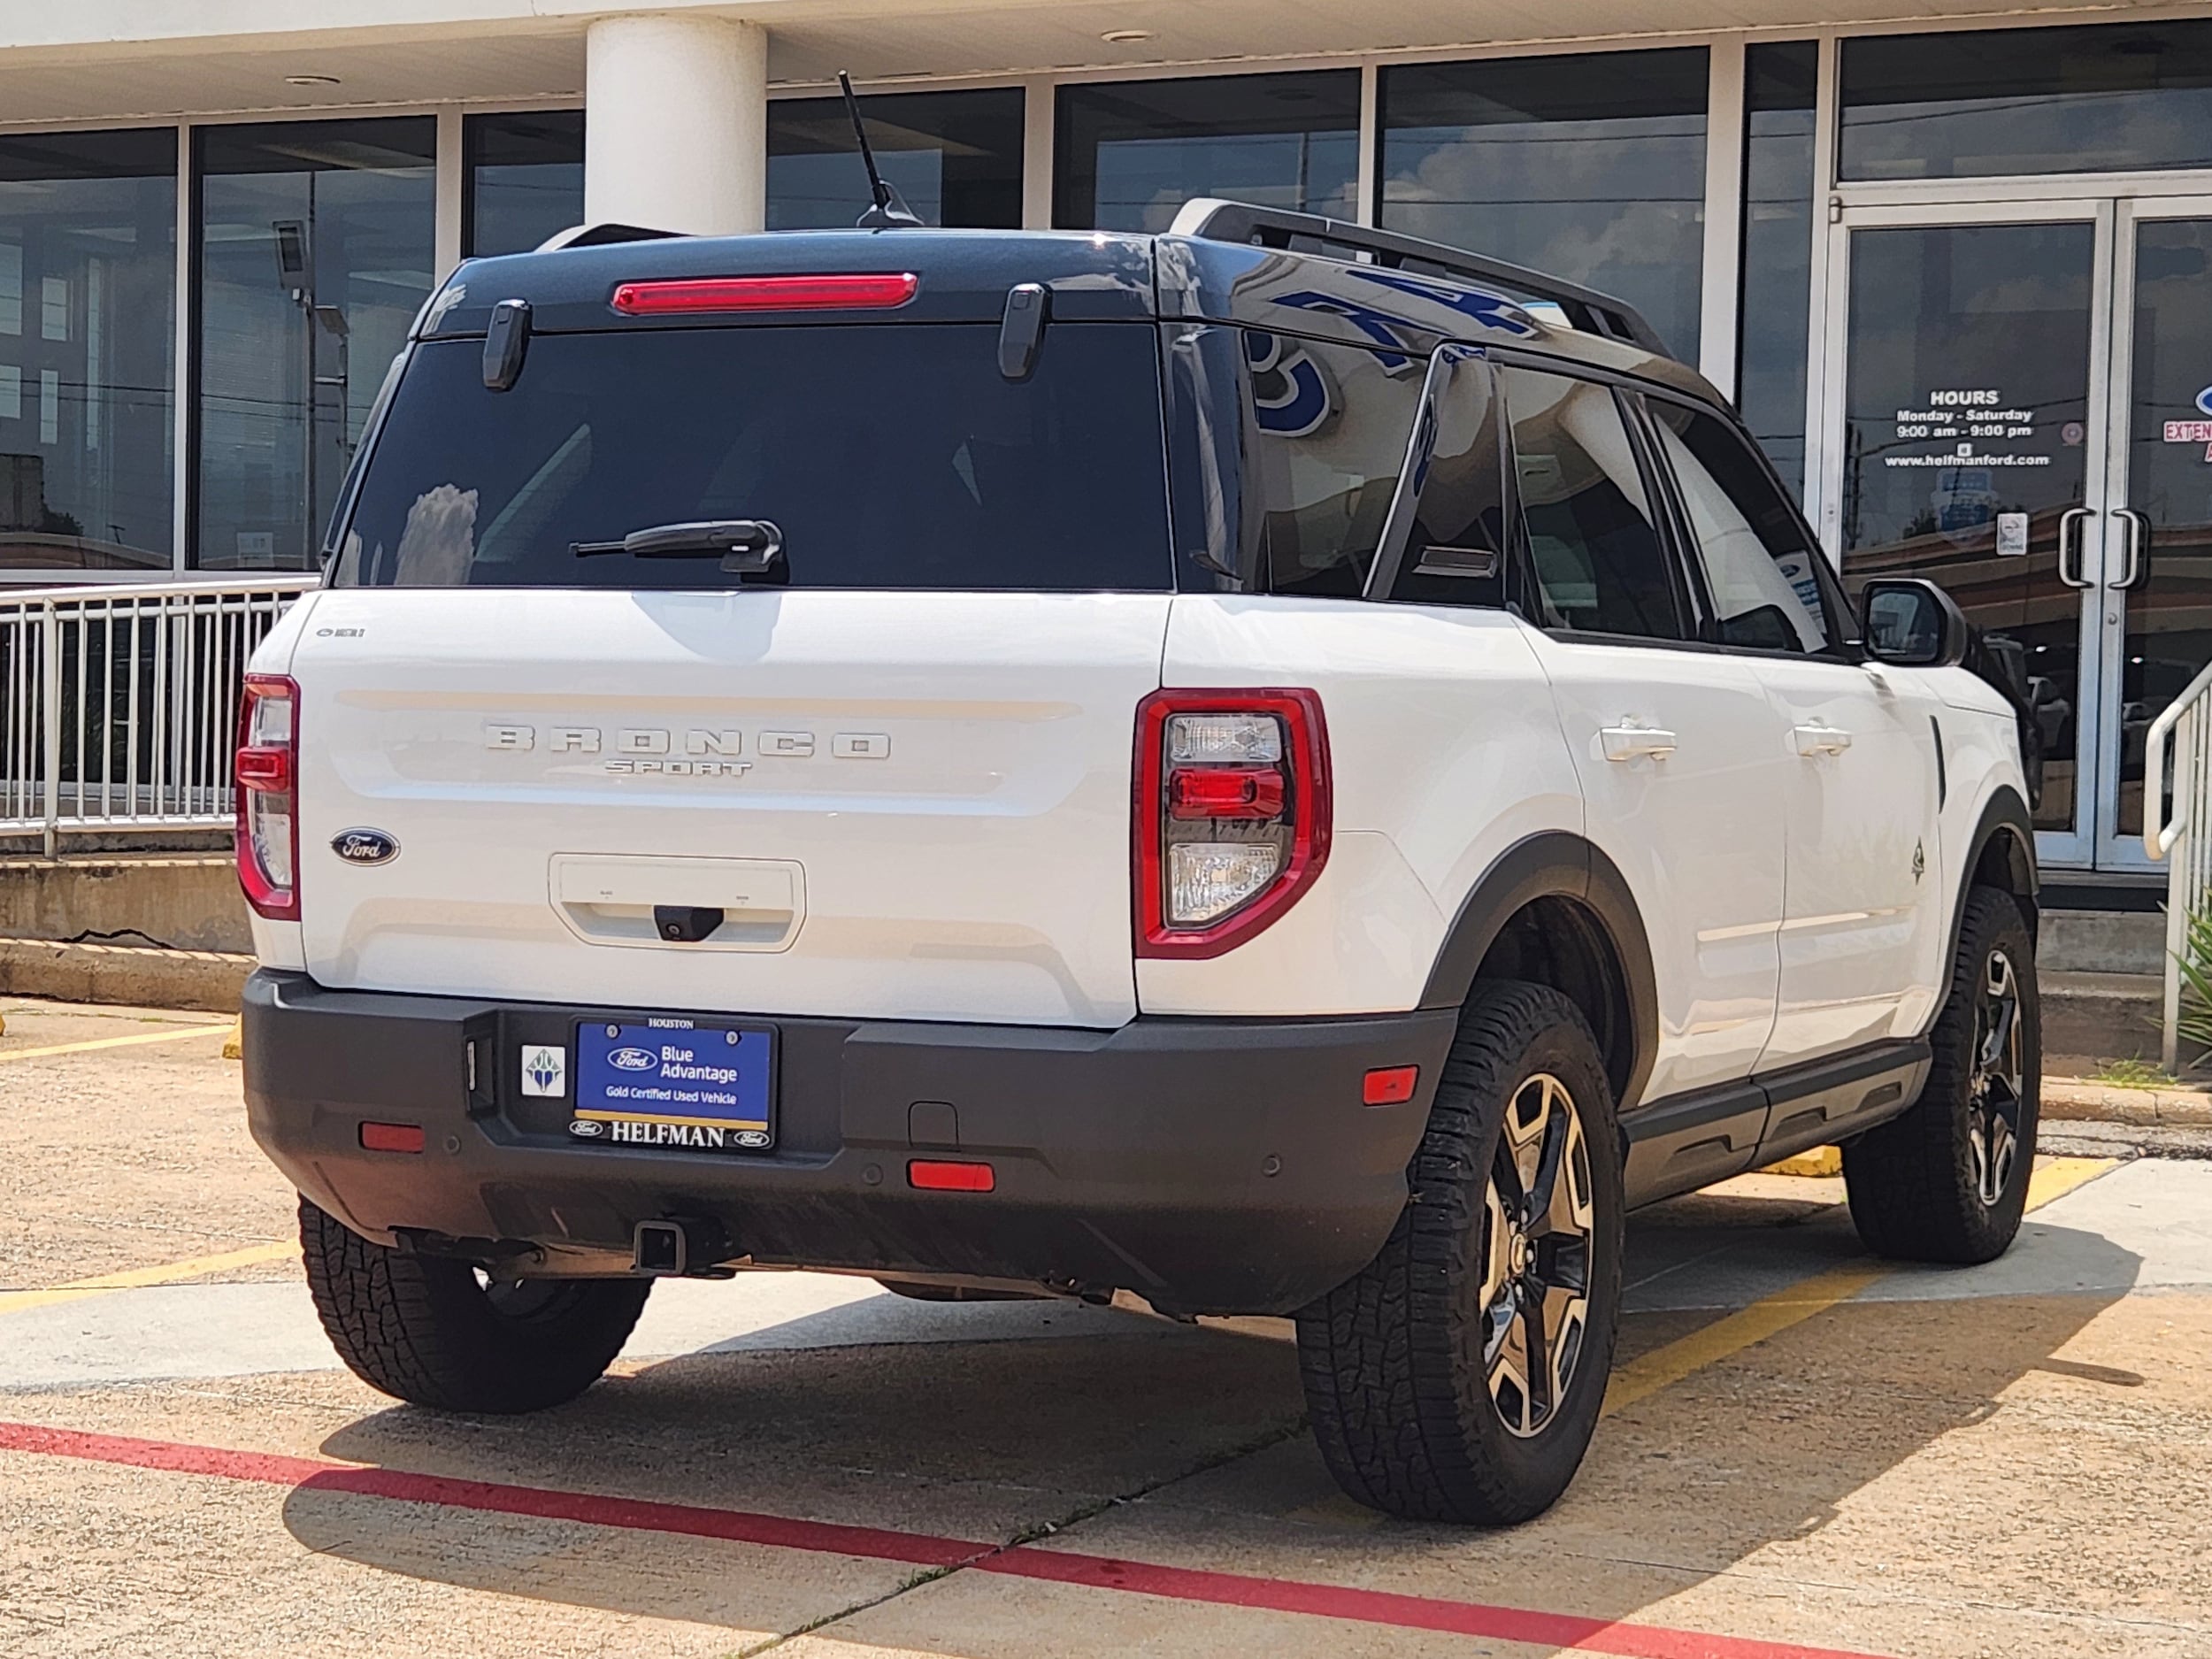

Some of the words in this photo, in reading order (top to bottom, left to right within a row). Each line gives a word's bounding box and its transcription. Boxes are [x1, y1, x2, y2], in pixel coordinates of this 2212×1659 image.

[1930, 390, 1999, 405] HOURS
[1897, 410, 1953, 423] Monday
[1965, 409, 2033, 422] Saturday
[1897, 426, 1928, 437] 9:00
[1933, 427, 1957, 437] am
[1970, 425, 2005, 436] 9:00
[2008, 426, 2032, 438] pm
[1885, 455, 2050, 466] www.helfmanford.com
[484, 724, 891, 759] BRONCO
[605, 759, 753, 776] SPORT
[342, 834, 381, 857] Ford
[649, 1018, 694, 1029] HOUSTON
[617, 1050, 649, 1067] Ford
[662, 1046, 694, 1062] Blue
[661, 1064, 737, 1084] Advantage
[606, 1086, 628, 1097] Gold
[631, 1087, 672, 1101] Certified
[673, 1090, 699, 1102] Used
[701, 1091, 737, 1105] Vehicle
[611, 1121, 725, 1148] HELFMAN
